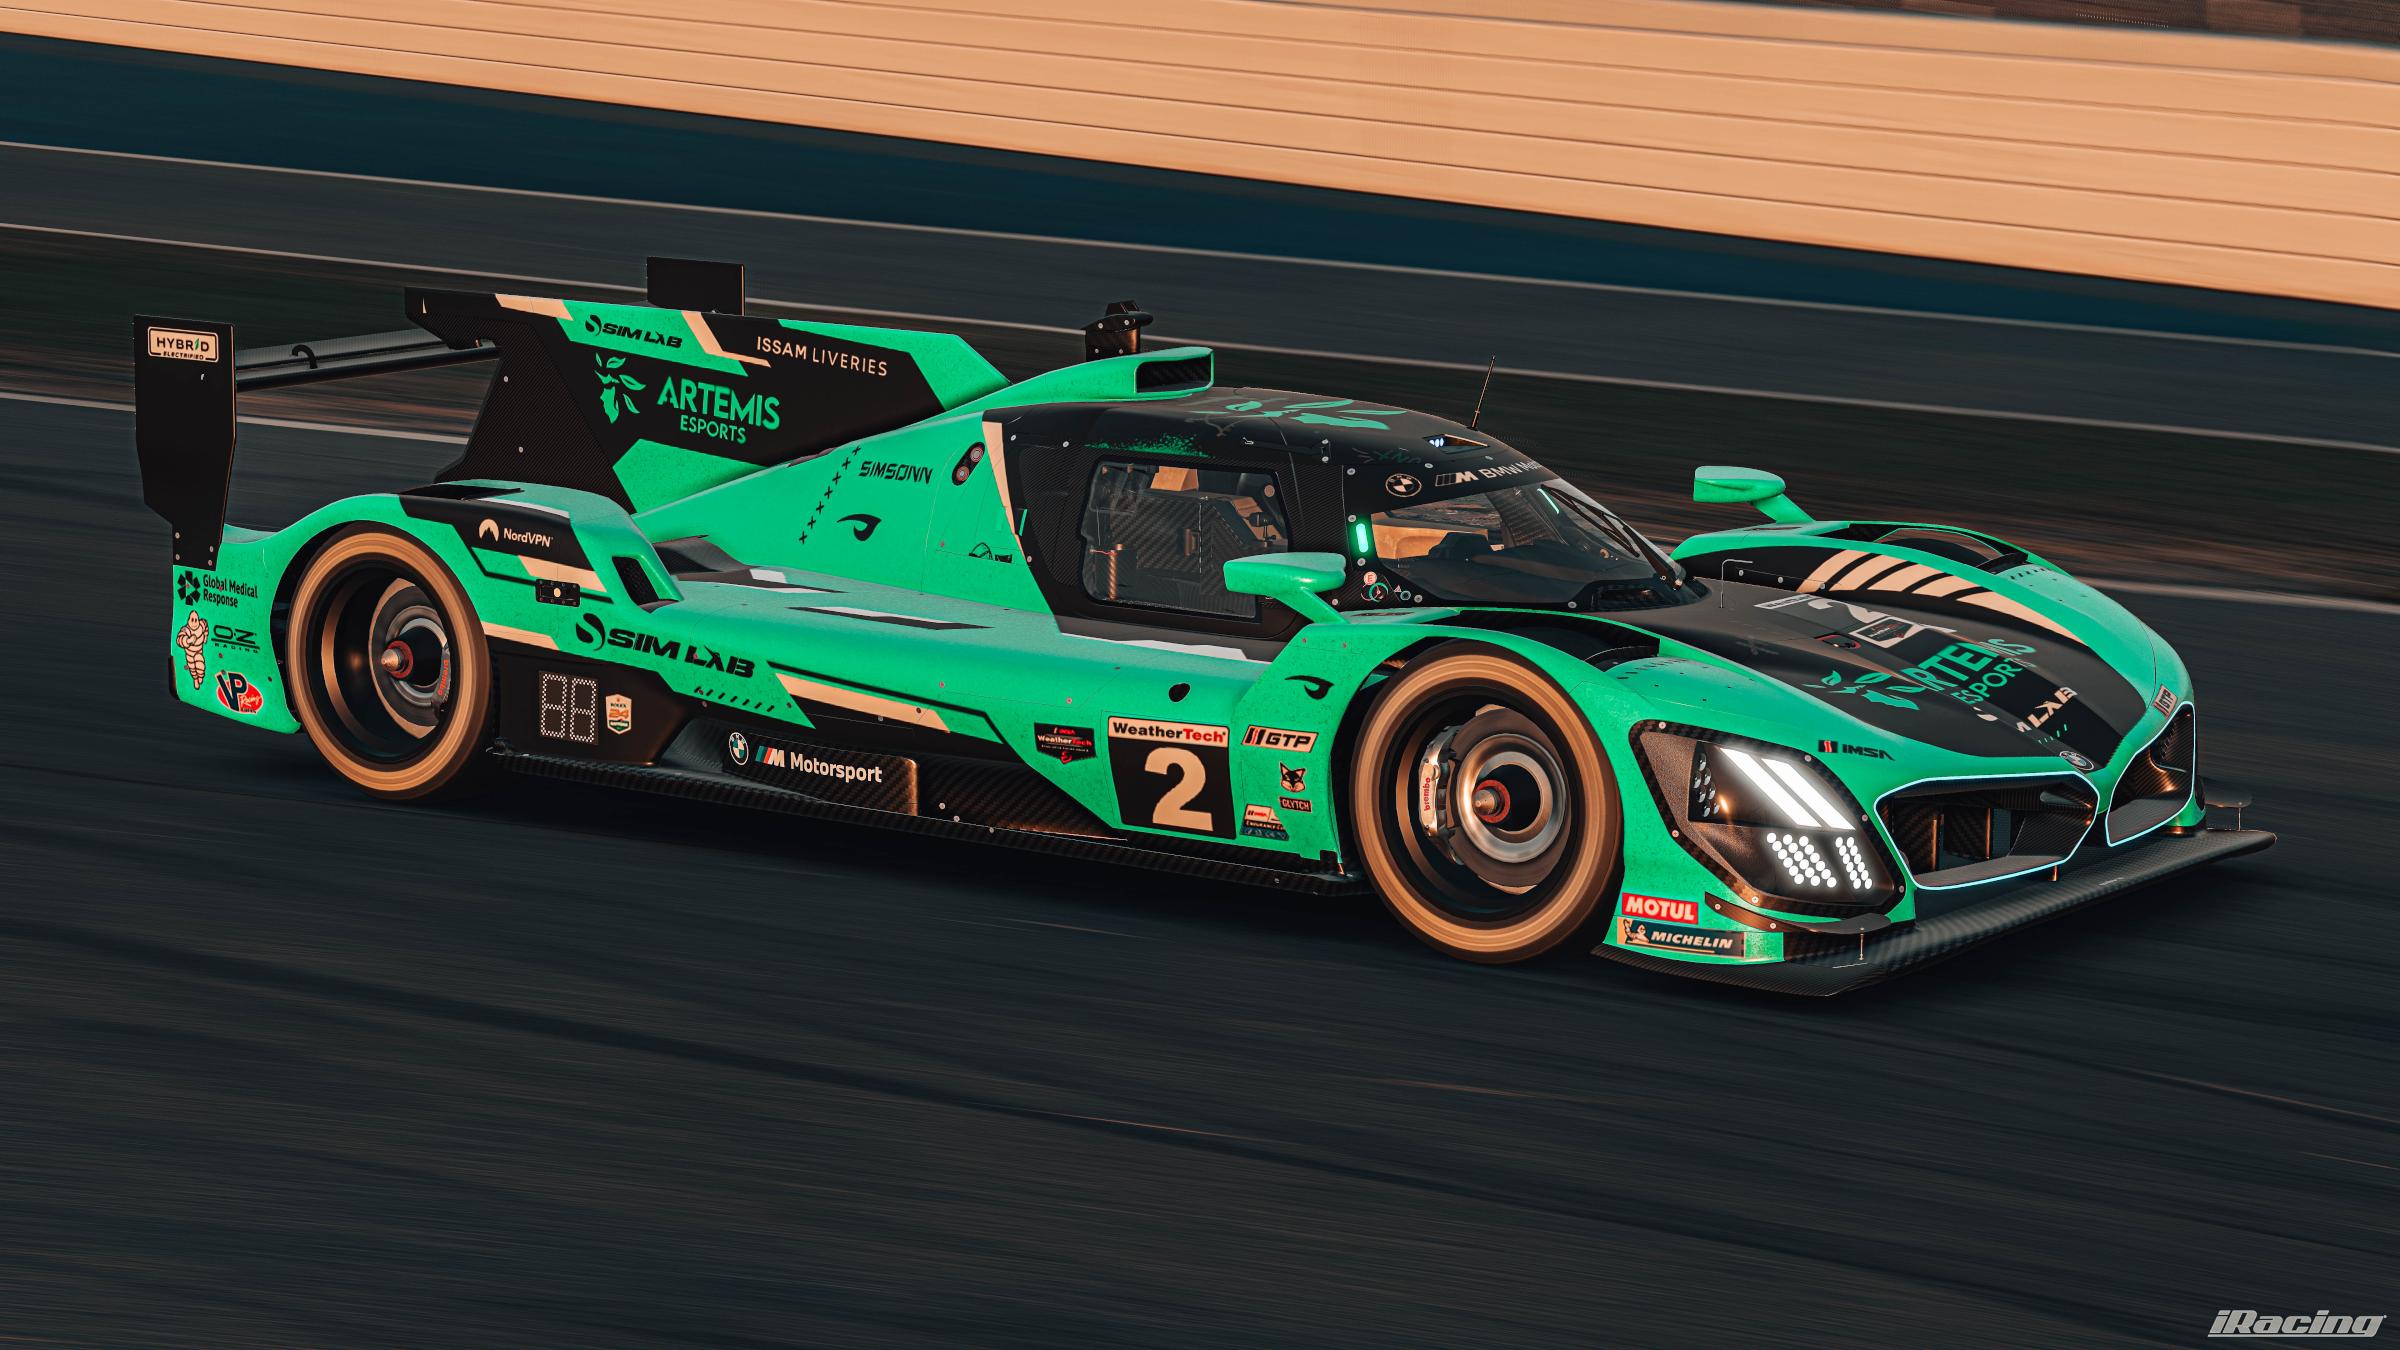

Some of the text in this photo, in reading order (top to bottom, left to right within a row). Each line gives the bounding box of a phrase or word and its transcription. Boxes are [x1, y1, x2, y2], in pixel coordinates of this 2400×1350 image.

[602, 322, 683, 349] SIM LAB
[756, 336, 888, 377] ISSAM LIVERIES
[656, 375, 781, 430] ARTEMIS
[680, 414, 747, 445] ESPORTS
[858, 460, 934, 485] SIMSONN
[503, 527, 552, 548] NordVPN
[202, 574, 258, 598] Global Medical
[203, 589, 239, 608] Response
[607, 628, 756, 679] SIM LAB
[216, 672, 248, 712] VP
[1037, 735, 1093, 747] WeatherTech
[1112, 721, 1224, 743] WeatherTech
[1265, 732, 1312, 748] GTP
[1842, 743, 1896, 761] IMSA
[790, 751, 883, 783] Motorsport
[1144, 746, 1214, 832] 2
[1423, 777, 1431, 811] brembo
[1281, 798, 1310, 811] GLYTCH
[1625, 896, 1695, 921] MOTUL
[1651, 931, 1734, 949] MICHELIN
